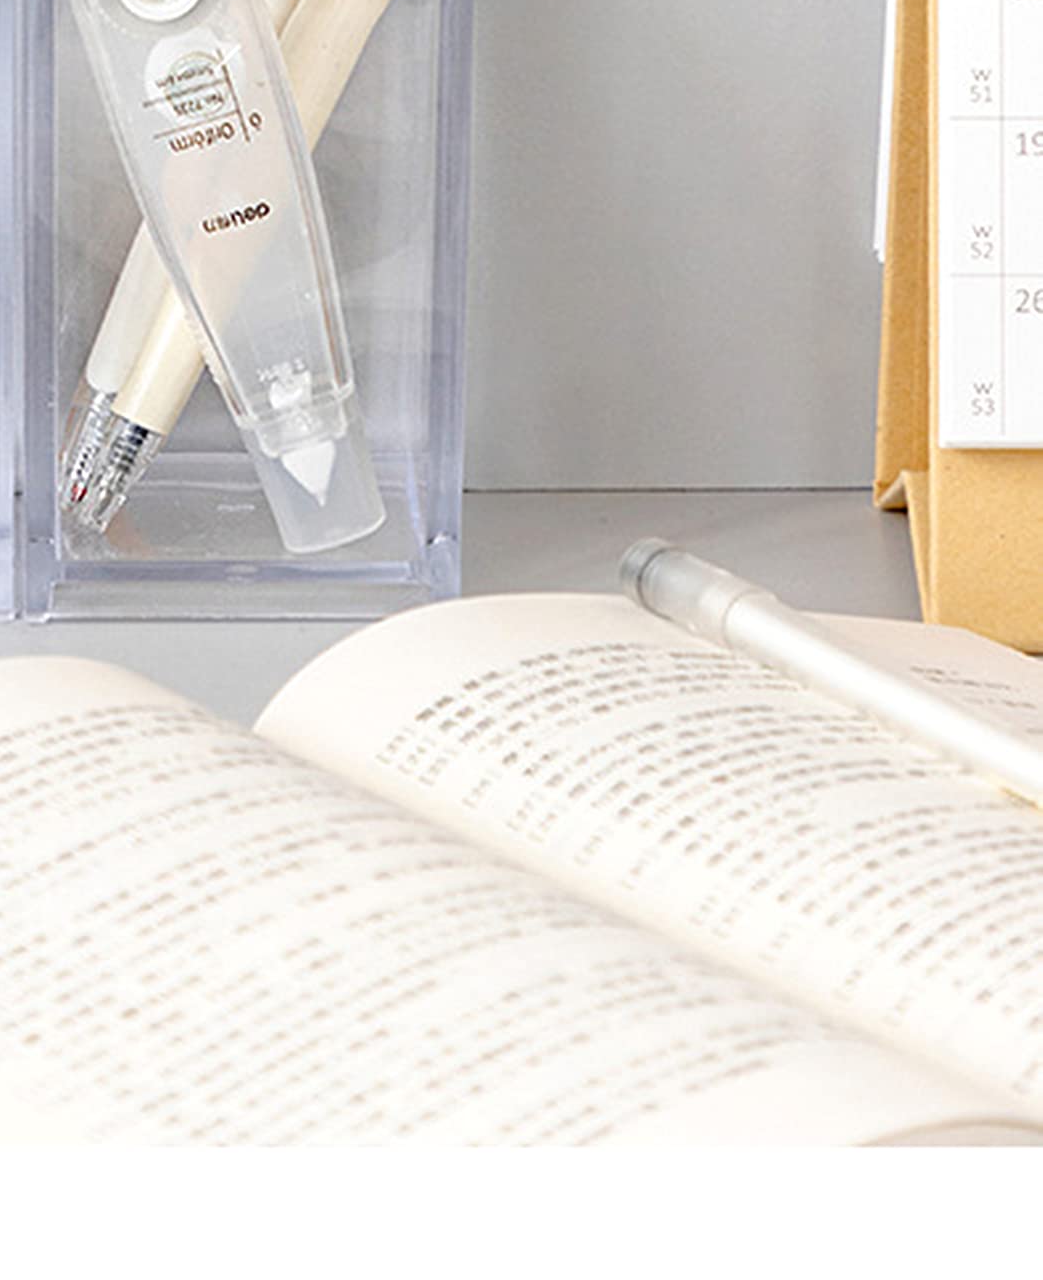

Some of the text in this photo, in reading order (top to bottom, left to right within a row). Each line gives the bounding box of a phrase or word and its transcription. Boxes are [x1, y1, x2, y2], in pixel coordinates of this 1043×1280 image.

[970, 85, 993, 103] 51
[970, 241, 994, 260] 52
[971, 398, 995, 417] 53
